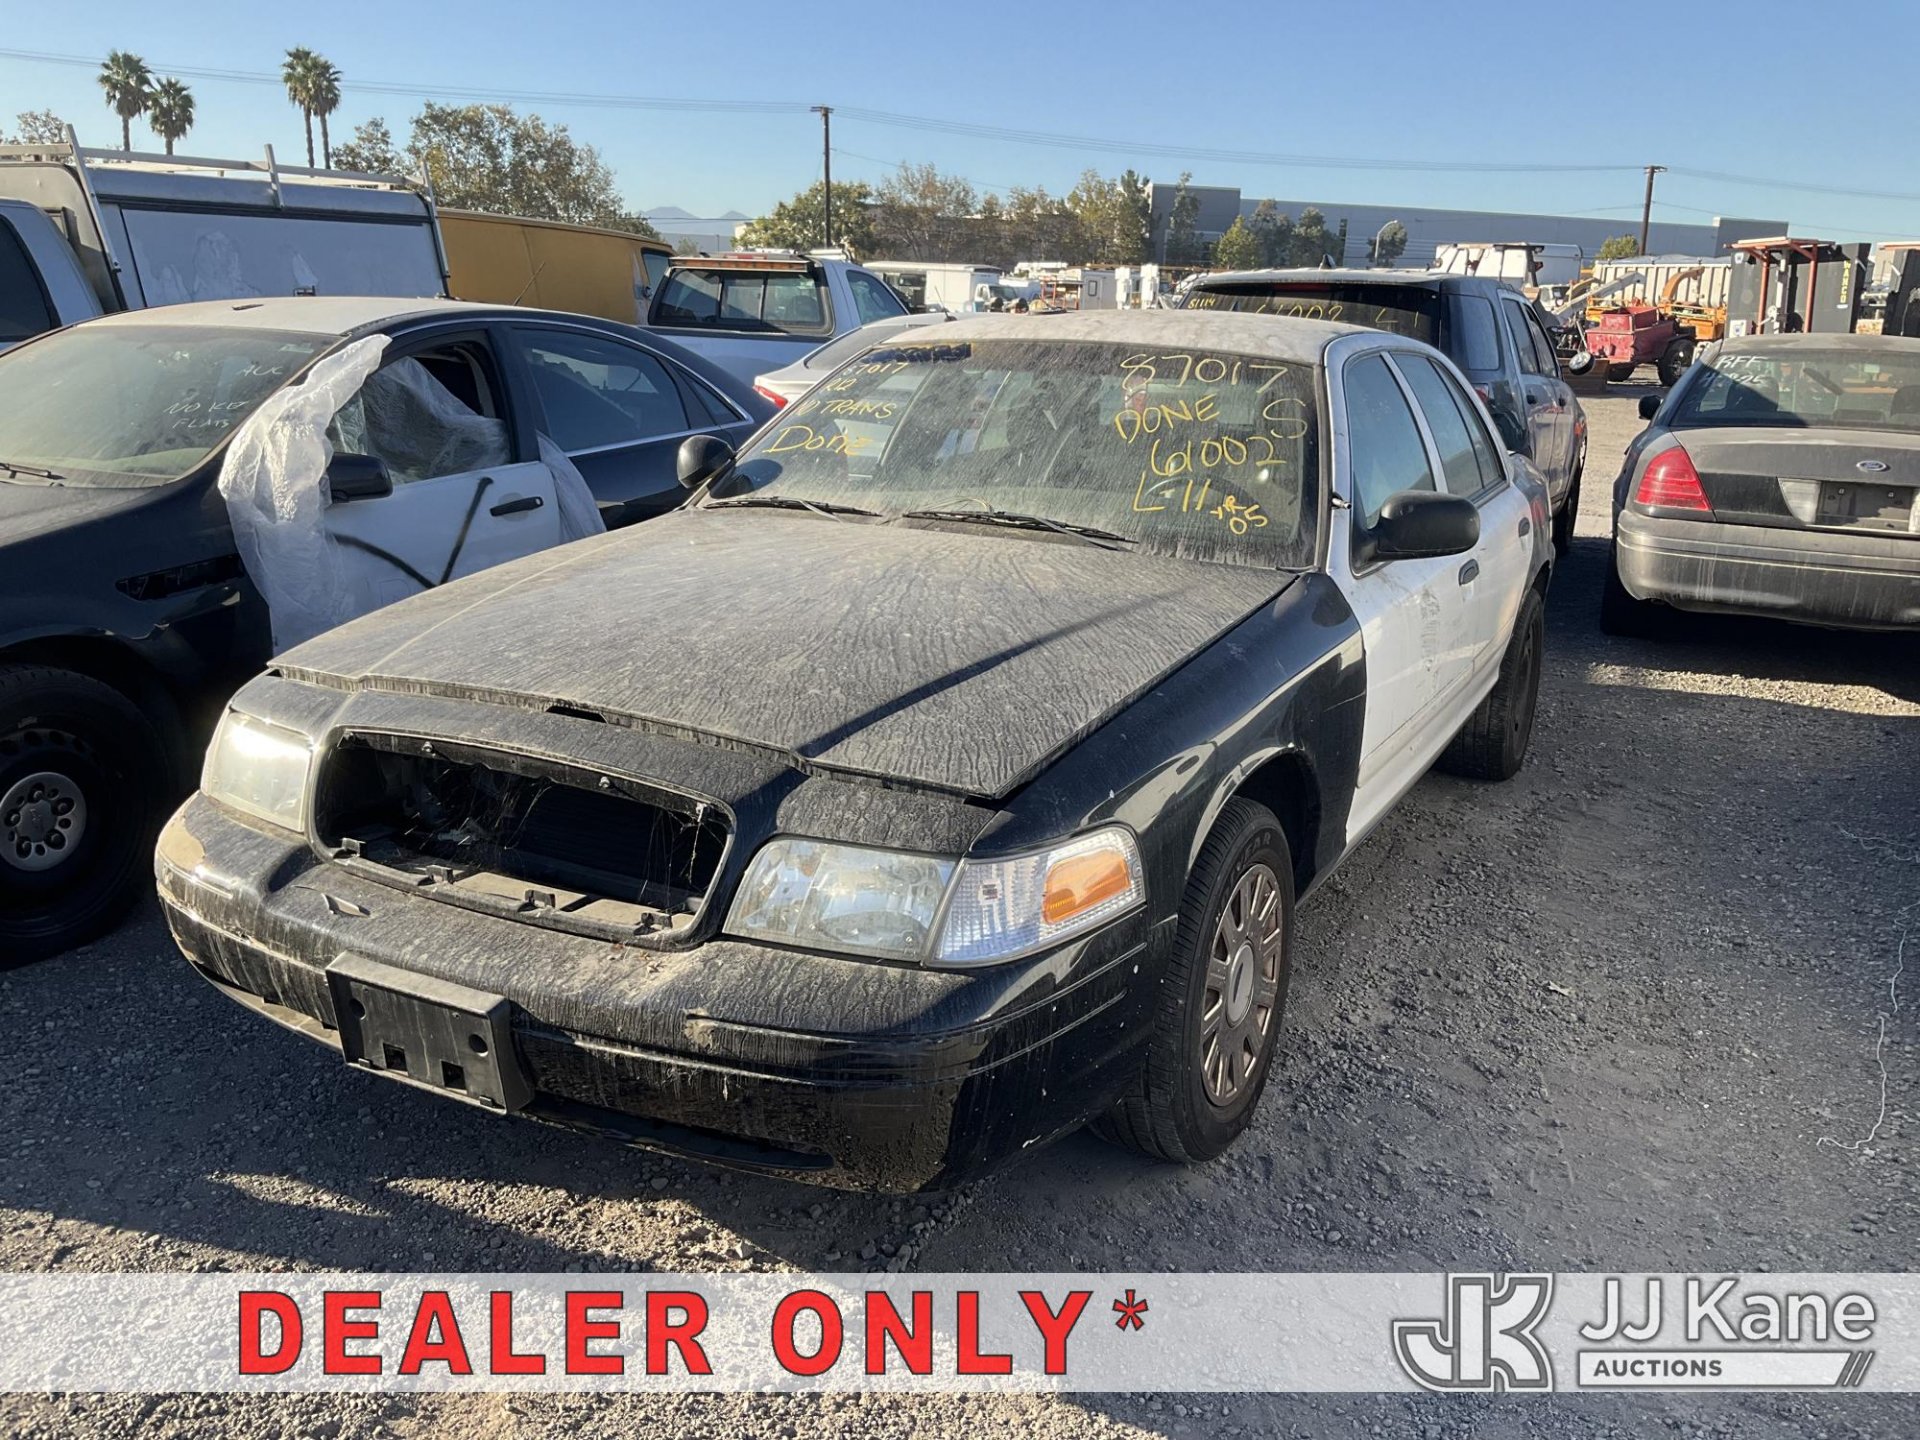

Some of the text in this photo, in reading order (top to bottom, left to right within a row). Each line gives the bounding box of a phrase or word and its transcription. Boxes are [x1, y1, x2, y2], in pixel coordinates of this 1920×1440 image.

[1120, 353, 1288, 394] 87017
[820, 399, 897, 419] TRANS
[1114, 393, 1221, 444] DONE
[1151, 436, 1287, 477] 61002
